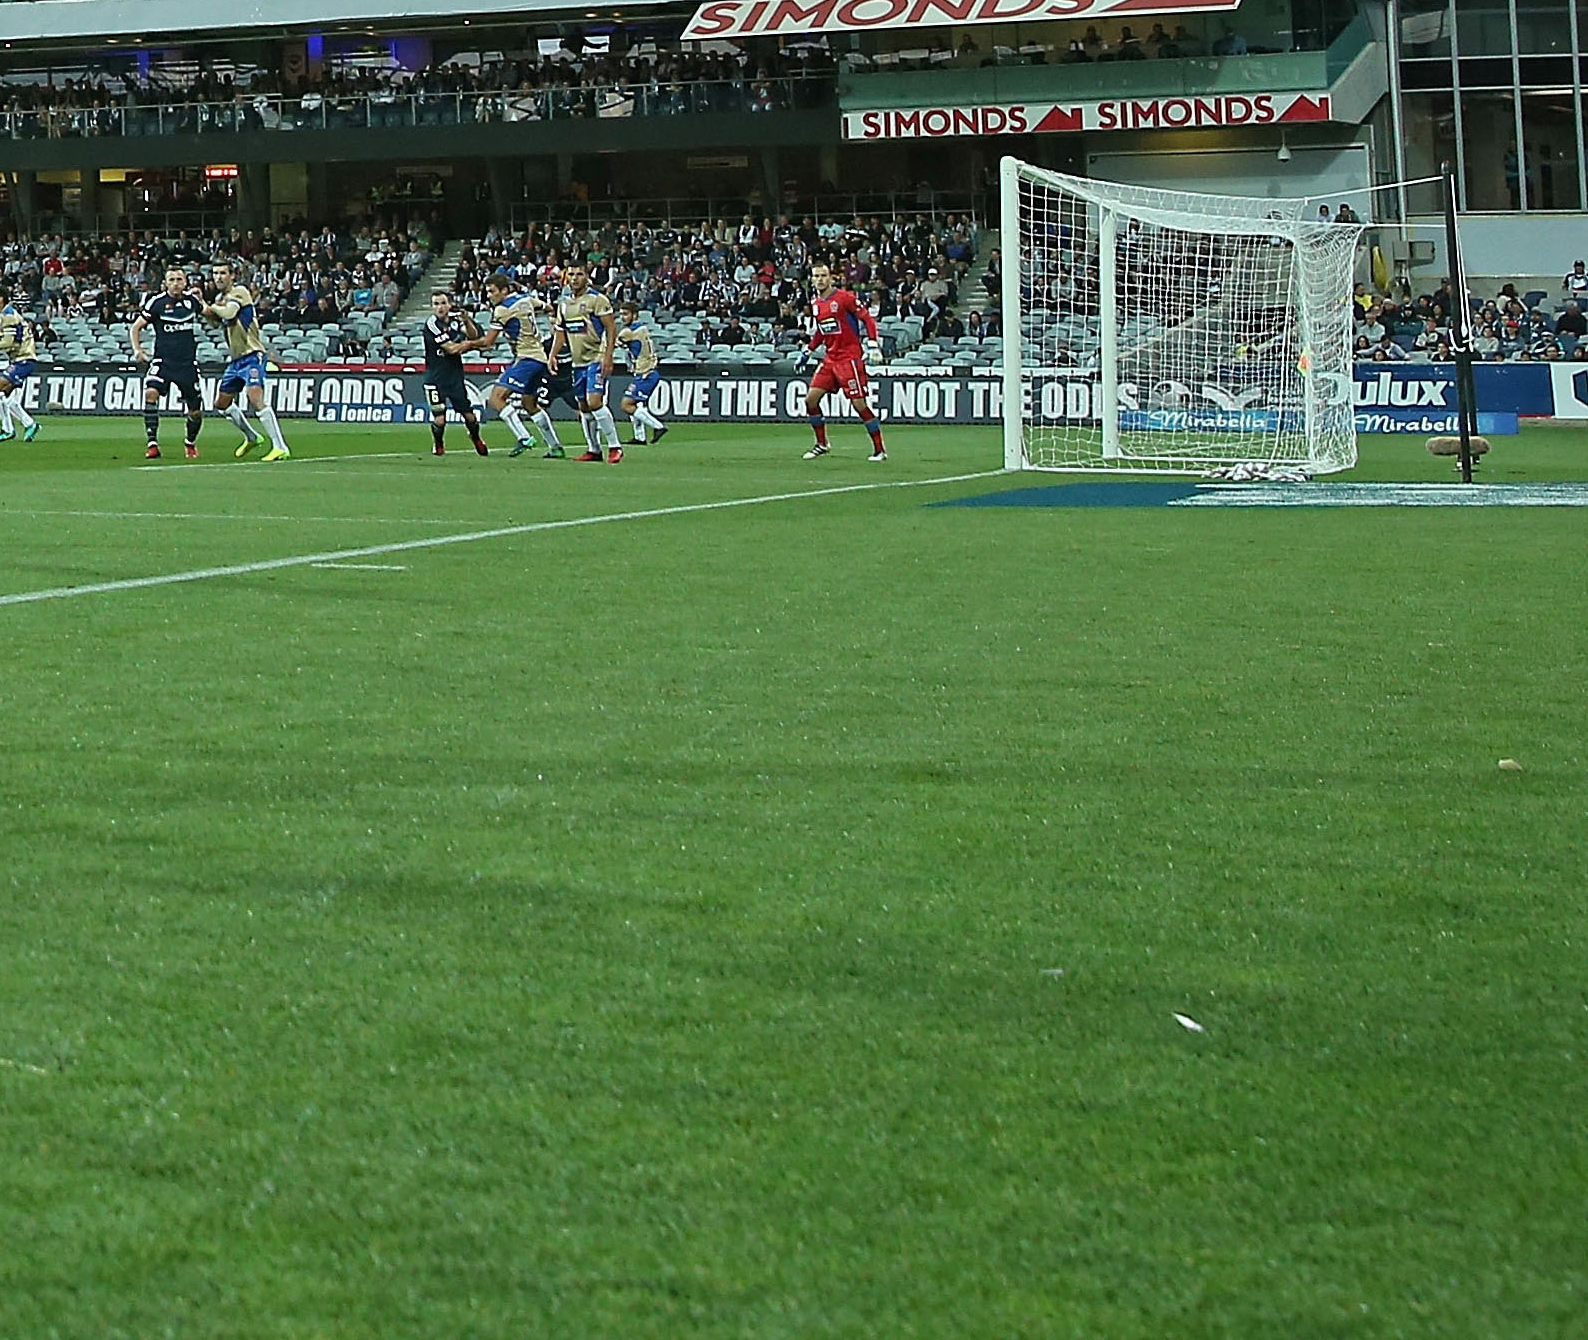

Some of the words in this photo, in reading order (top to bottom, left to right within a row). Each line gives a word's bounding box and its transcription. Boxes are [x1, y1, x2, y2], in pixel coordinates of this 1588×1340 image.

[863, 106, 1028, 138] SIMONDS
[1098, 95, 1275, 129] SIMONDS
[47, 375, 98, 410] THE
[262, 377, 314, 412] THE
[320, 377, 405, 405] ODDS
[430, 390, 439, 403] 6
[649, 379, 711, 417] OVE
[716, 380, 778, 417] THE
[892, 381, 961, 418] NOT
[1317, 371, 1449, 406] Dulux
[317, 404, 337, 422] La
[405, 406, 425, 422] La
[1150, 410, 1266, 429] Mirabella
[1354, 414, 1471, 433] Mirabell
